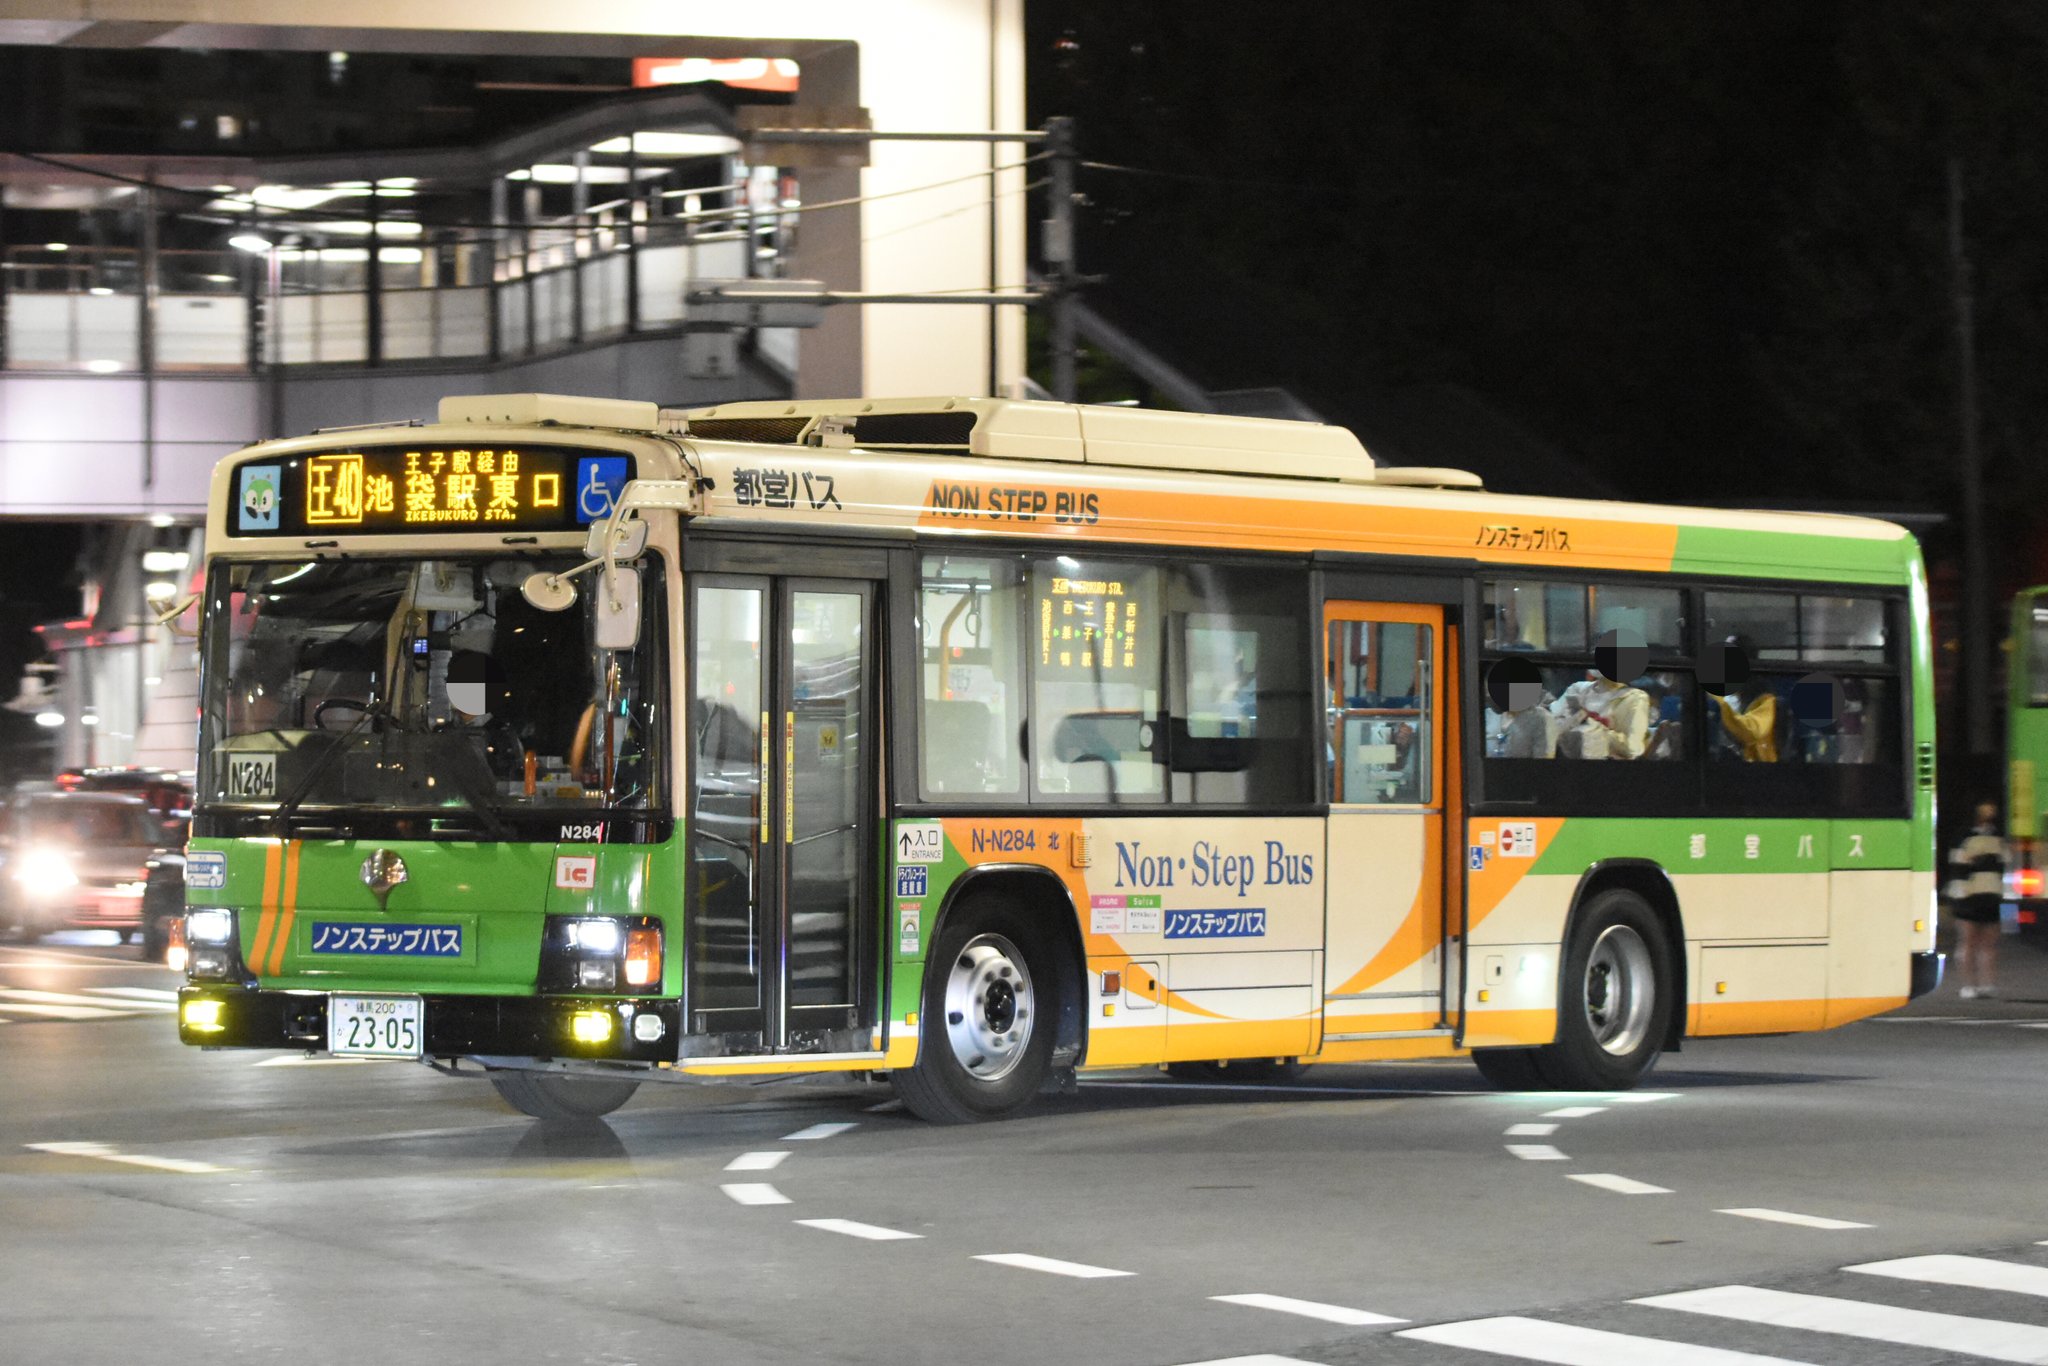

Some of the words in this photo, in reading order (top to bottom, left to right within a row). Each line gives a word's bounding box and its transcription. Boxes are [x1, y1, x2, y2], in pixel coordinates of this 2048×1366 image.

[405, 451, 519, 475] 王子駅経由
[365, 472, 560, 512] 池袋駅東口
[733, 467, 843, 511] 都営バス
[405, 508, 479, 522] IKEBUKURO
[484, 508, 517, 521] STA.
[931, 483, 981, 518] NON
[987, 487, 1048, 522] STEP
[1055, 492, 1101, 525] BUS
[1475, 525, 1571, 551] ノンステップバス
[231, 761, 274, 796] N284
[561, 825, 601, 840] N284
[914, 829, 939, 847] 入口
[972, 828, 1036, 853] N-N284
[1048, 831, 1060, 850] 北
[911, 850, 942, 860] ENTRANCE
[1263, 840, 1314, 886] Bus
[1164, 912, 1266, 936] ノンステップバス
[313, 926, 461, 953] ノンステップバス
[348, 1016, 415, 1049] 23-05
